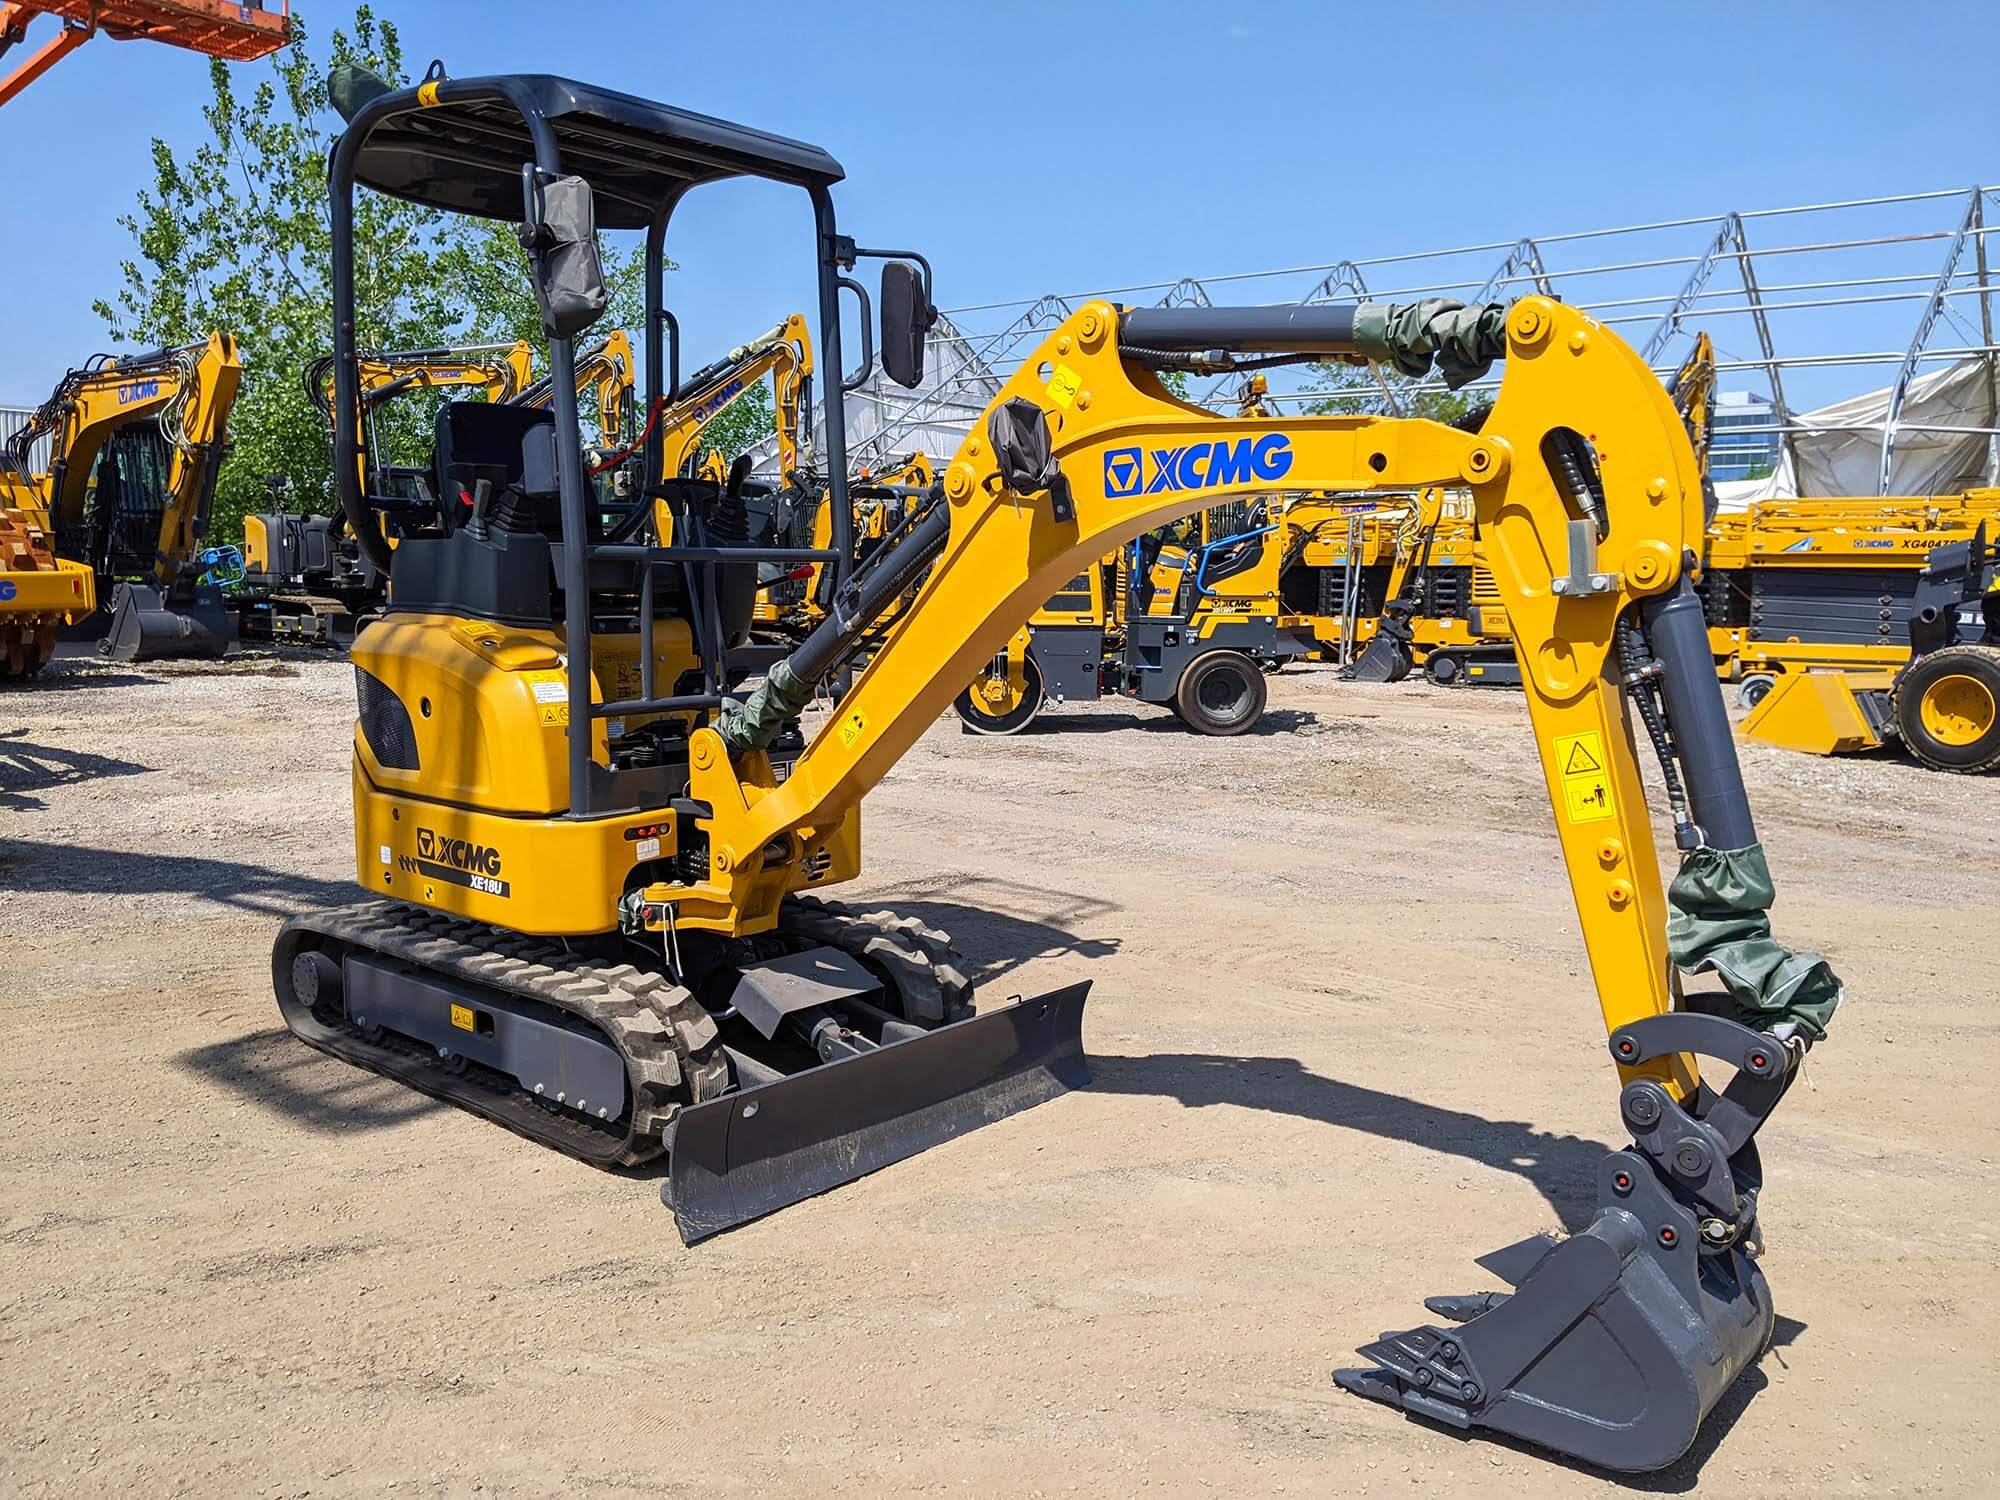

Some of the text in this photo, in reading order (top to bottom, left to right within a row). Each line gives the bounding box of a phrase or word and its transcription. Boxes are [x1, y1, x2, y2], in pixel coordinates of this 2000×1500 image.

[1144, 433, 1293, 494] XCMG
[1221, 600, 1252, 609] XCMG
[436, 835, 501, 877] XCMG
[470, 874, 502, 895] XE18U
